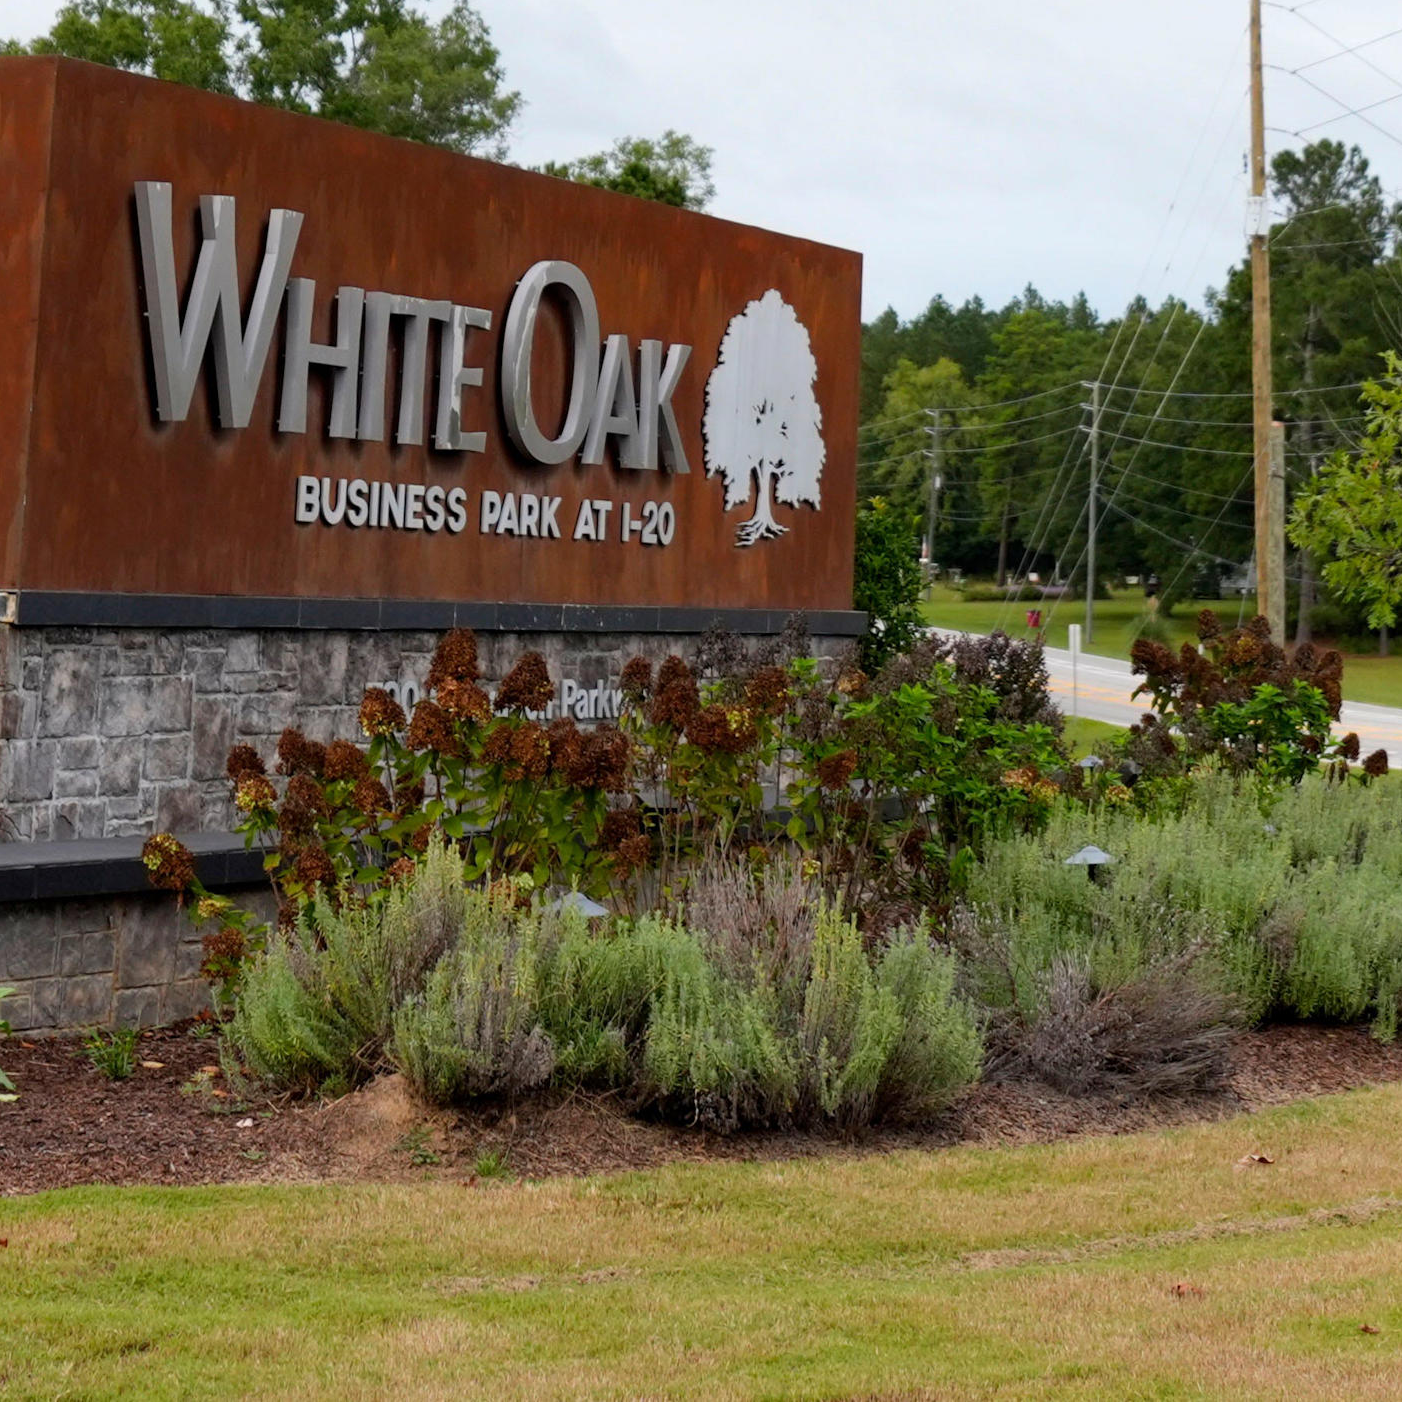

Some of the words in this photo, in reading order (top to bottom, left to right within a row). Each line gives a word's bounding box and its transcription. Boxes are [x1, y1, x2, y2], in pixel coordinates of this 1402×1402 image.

[134, 181, 491, 452] WHITE
[502, 260, 692, 474] OAK
[296, 475, 467, 533] BUSINESS
[480, 490, 562, 538] PARK
[573, 499, 612, 541] AT
[621, 501, 675, 546] I-20
